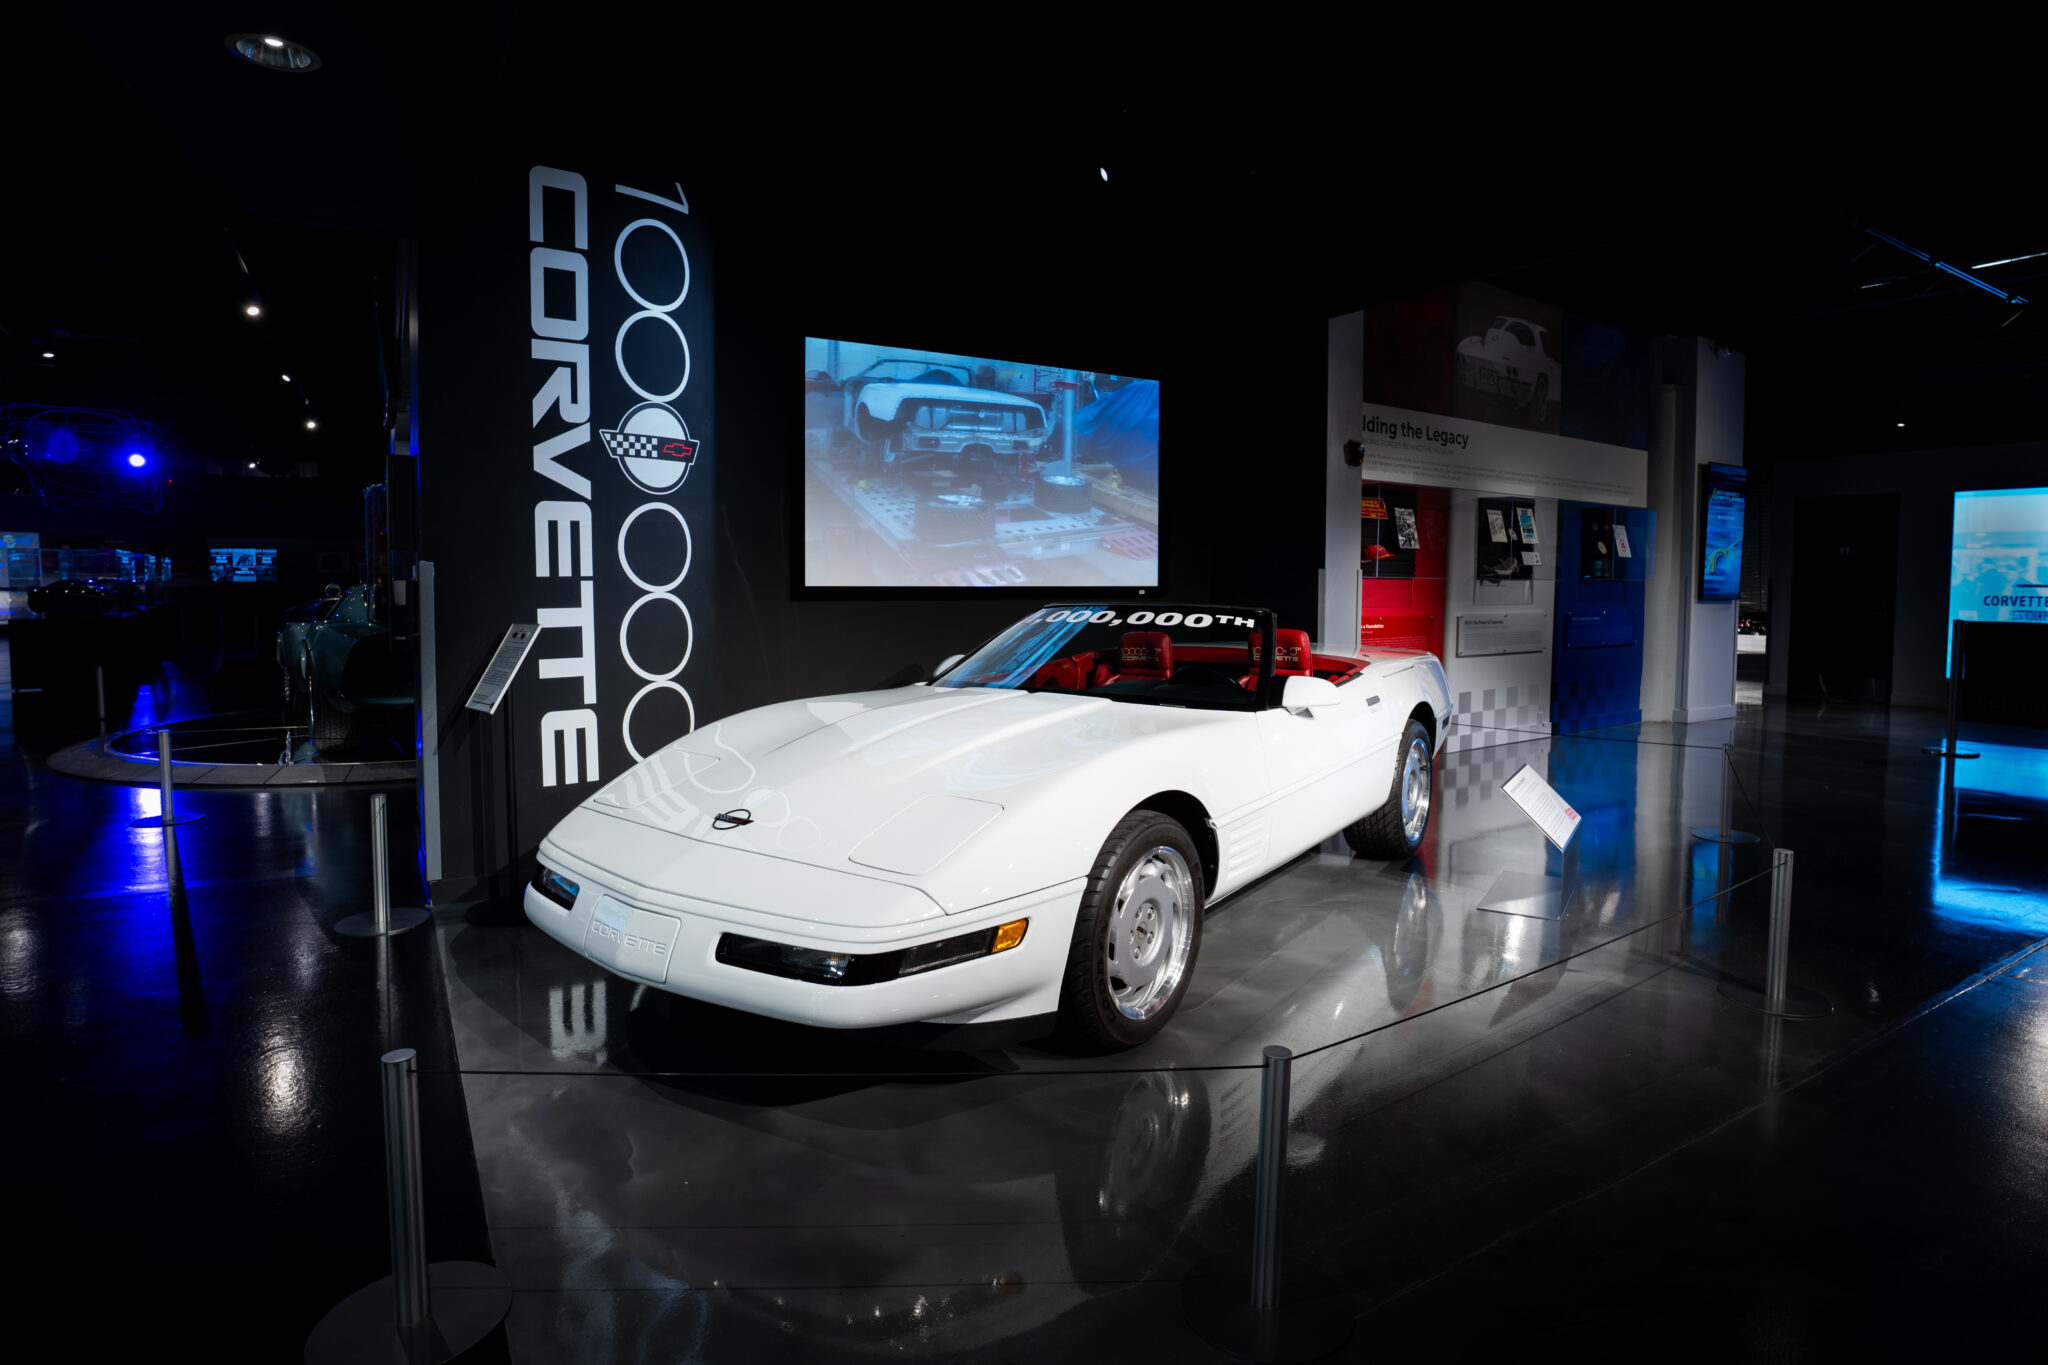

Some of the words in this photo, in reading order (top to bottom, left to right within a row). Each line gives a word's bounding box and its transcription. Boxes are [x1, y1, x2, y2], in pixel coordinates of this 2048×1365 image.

[1362, 414, 1397, 440] lding
[1400, 420, 1423, 439] the
[1426, 425, 1469, 450] Legacy
[529, 165, 600, 788] CORVETTE
[591, 918, 667, 957] CORVETTE
